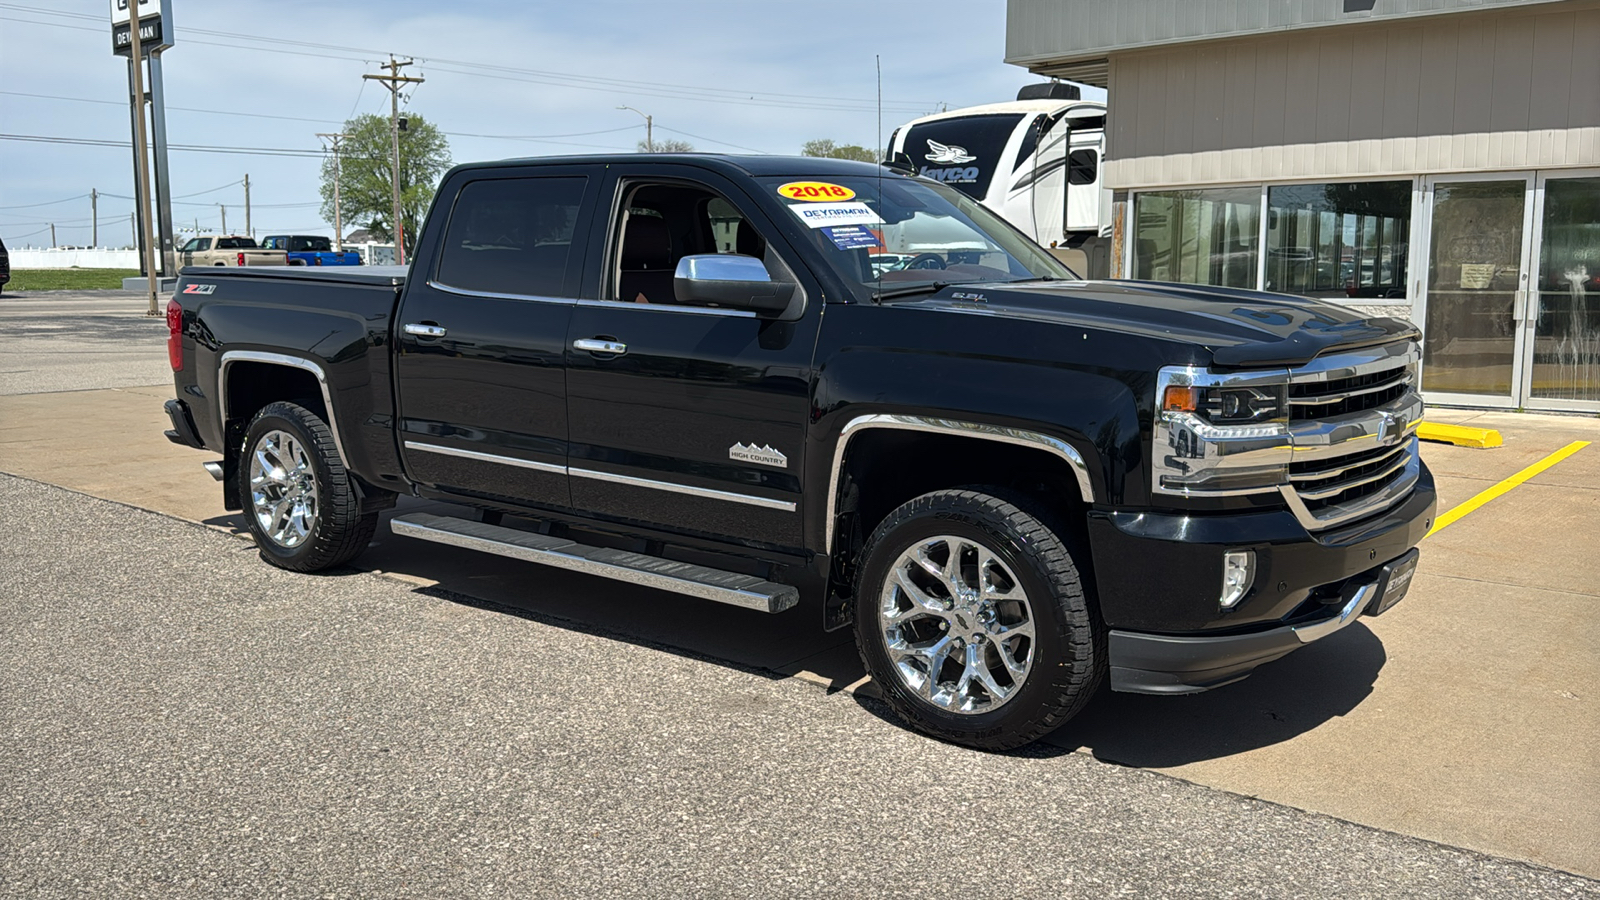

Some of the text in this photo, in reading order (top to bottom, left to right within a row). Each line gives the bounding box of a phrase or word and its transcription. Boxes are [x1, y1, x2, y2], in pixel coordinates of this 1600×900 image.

[117, 26, 154, 45] DEYMAN
[788, 186, 847, 198] 2018
[803, 208, 870, 218] DEYARMAN
[182, 284, 217, 295] Z71
[731, 451, 784, 465] HIGH COUNTRY
